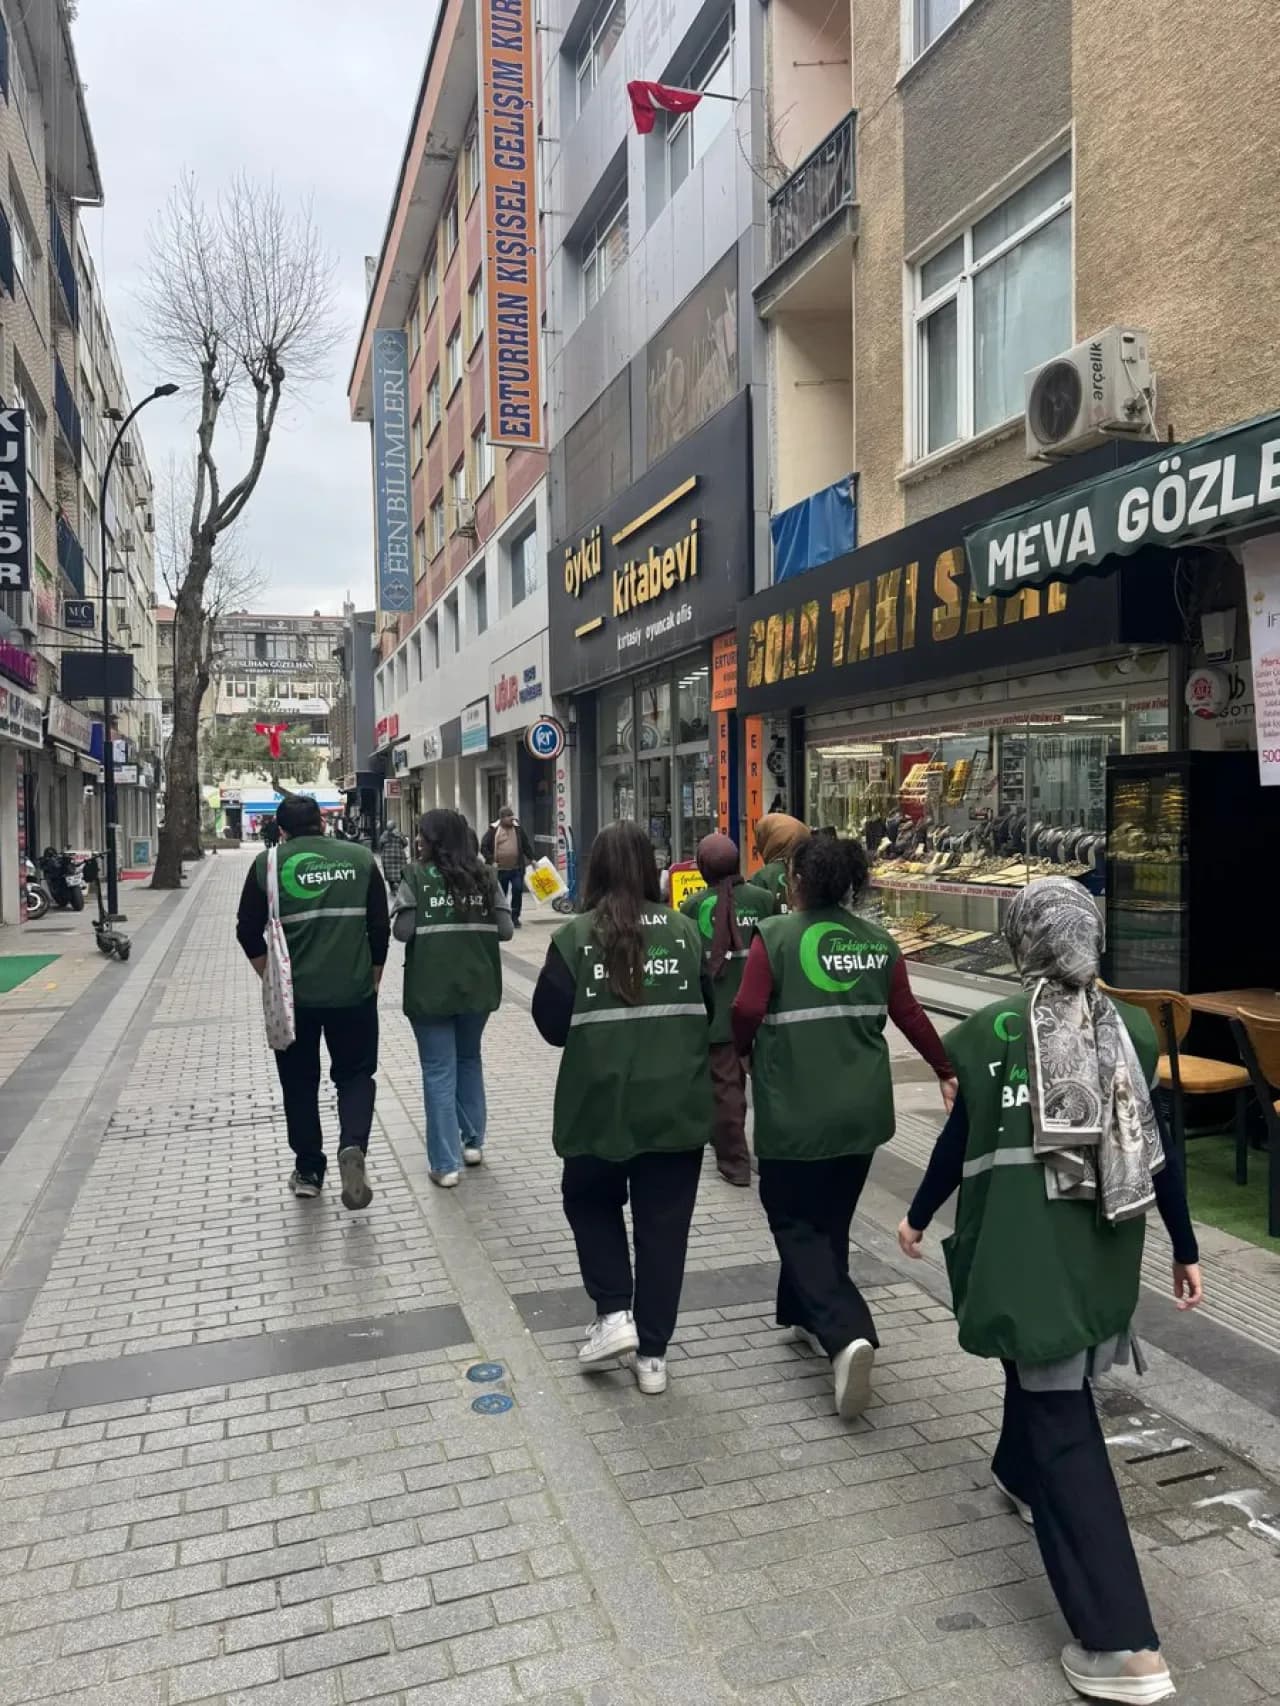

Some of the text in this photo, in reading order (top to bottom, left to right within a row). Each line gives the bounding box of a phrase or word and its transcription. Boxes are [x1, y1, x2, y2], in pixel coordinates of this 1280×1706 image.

[484, 63, 534, 173] GELİŞİM
[488, 180, 537, 285] KİŞİSEL
[499, 293, 531, 438] ERTURHAN
[379, 367, 409, 576] FEN BİLİMLERİ
[988, 438, 1280, 587] MEVA GÖZLE
[565, 524, 602, 598] öykü
[613, 517, 698, 617] kitabevi
[747, 600, 820, 688] GOLD
[831, 561, 920, 668] TAKI
